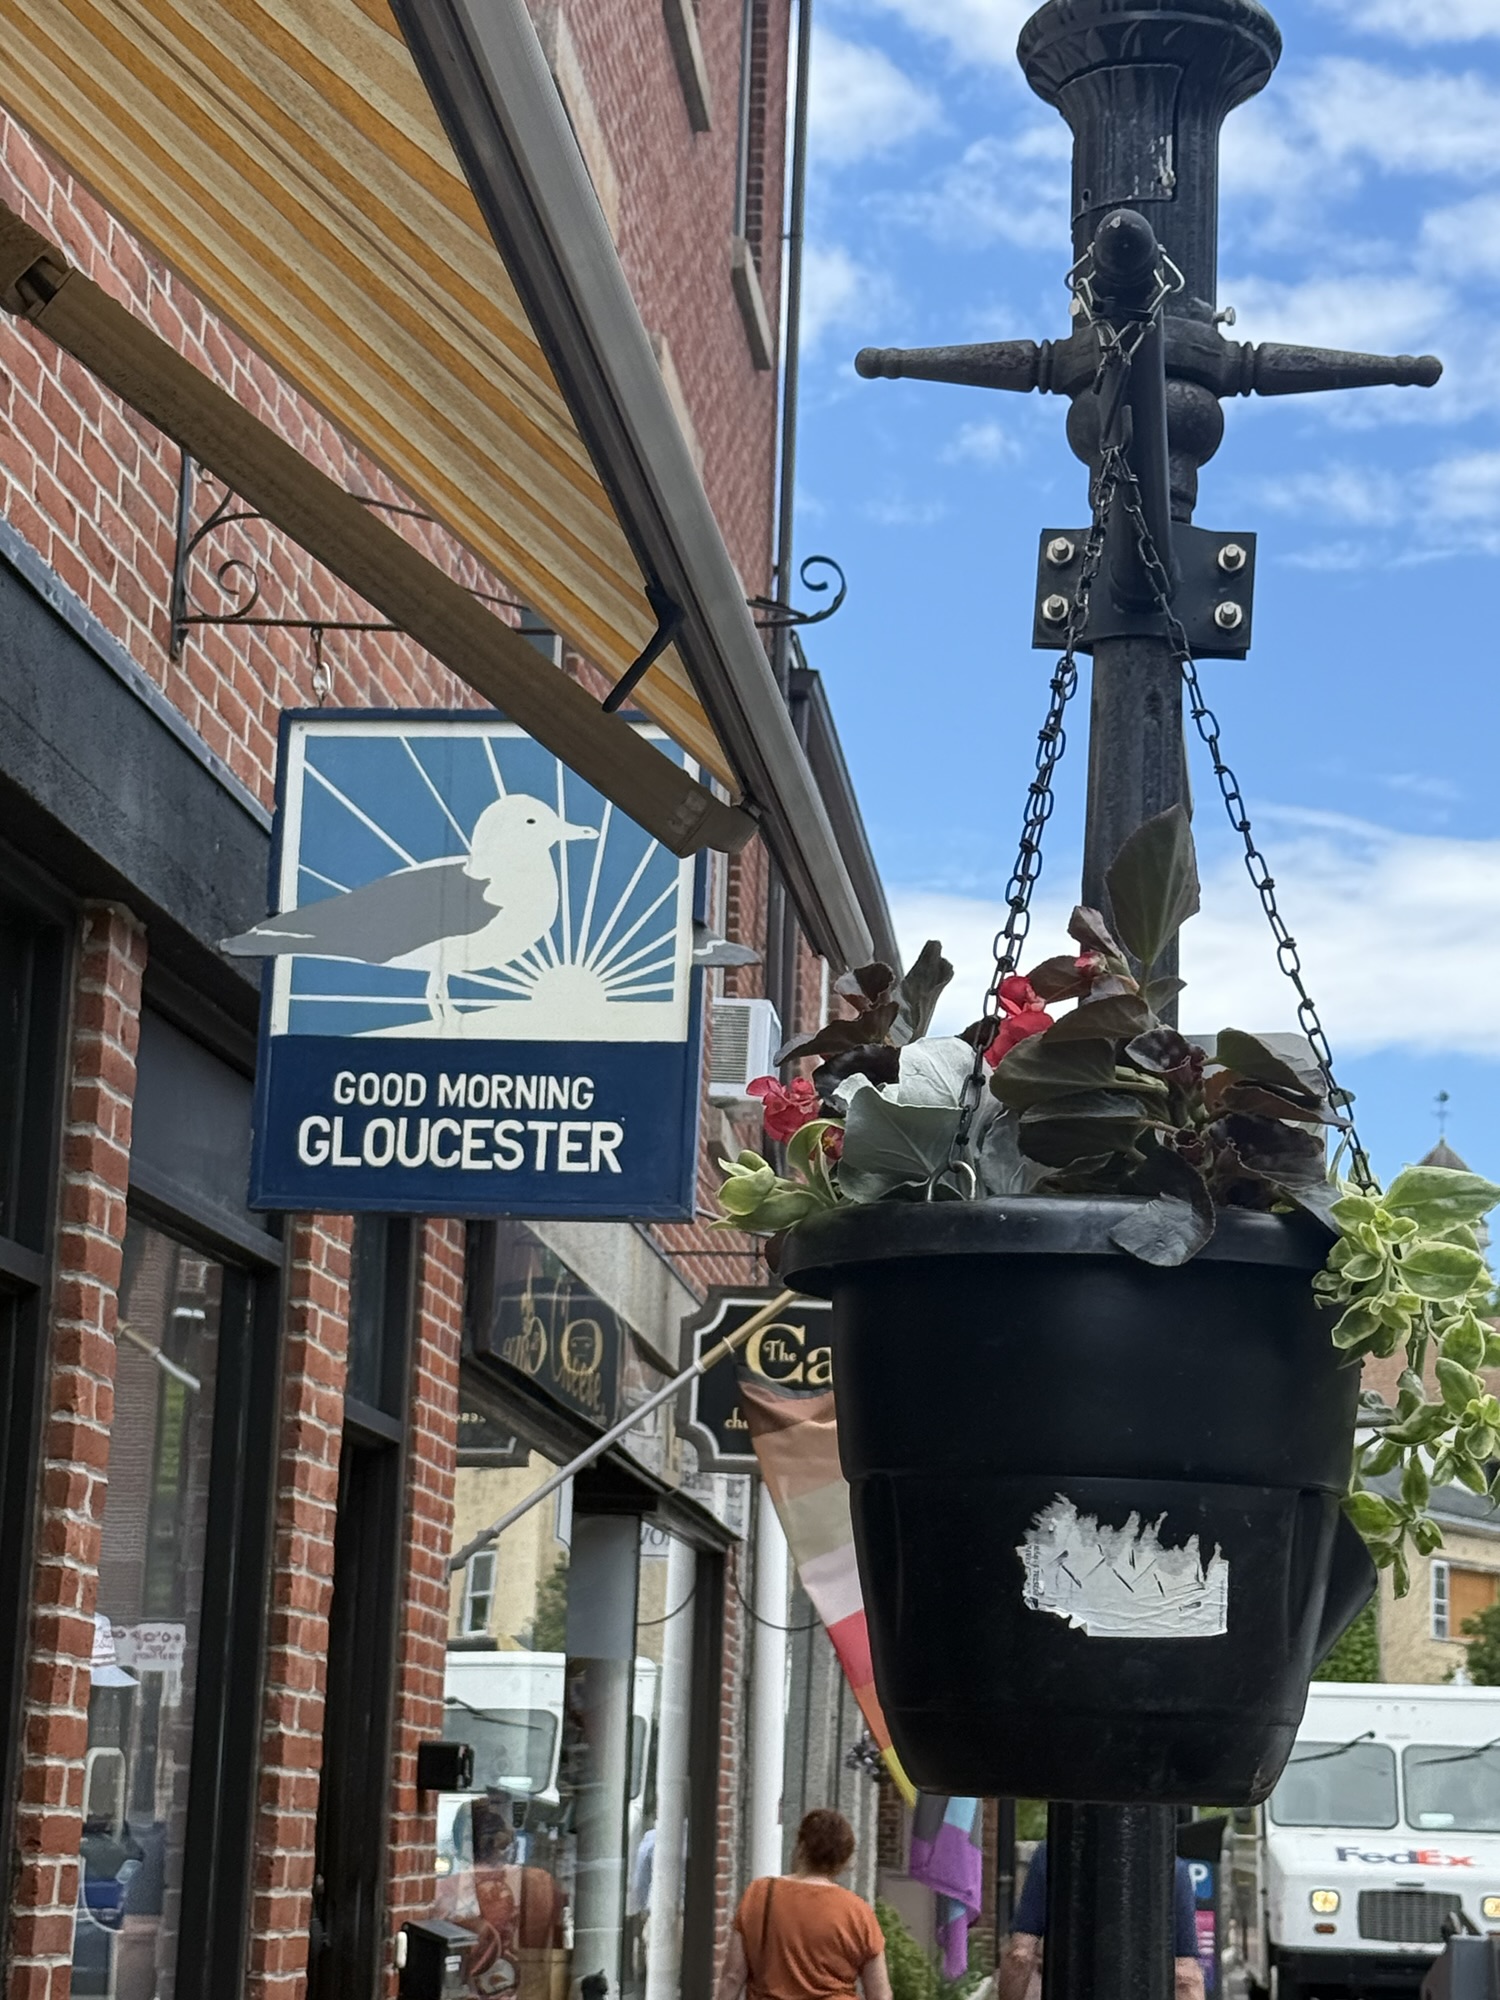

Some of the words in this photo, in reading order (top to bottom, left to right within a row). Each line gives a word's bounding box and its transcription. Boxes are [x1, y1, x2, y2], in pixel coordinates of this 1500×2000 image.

[333, 1070, 427, 1107] GOOD
[437, 1073, 595, 1110] MORNING
[298, 1115, 625, 1174] GLOUCESTER
[762, 1339, 798, 1362] The
[1335, 1846, 1477, 1867] FedEx
